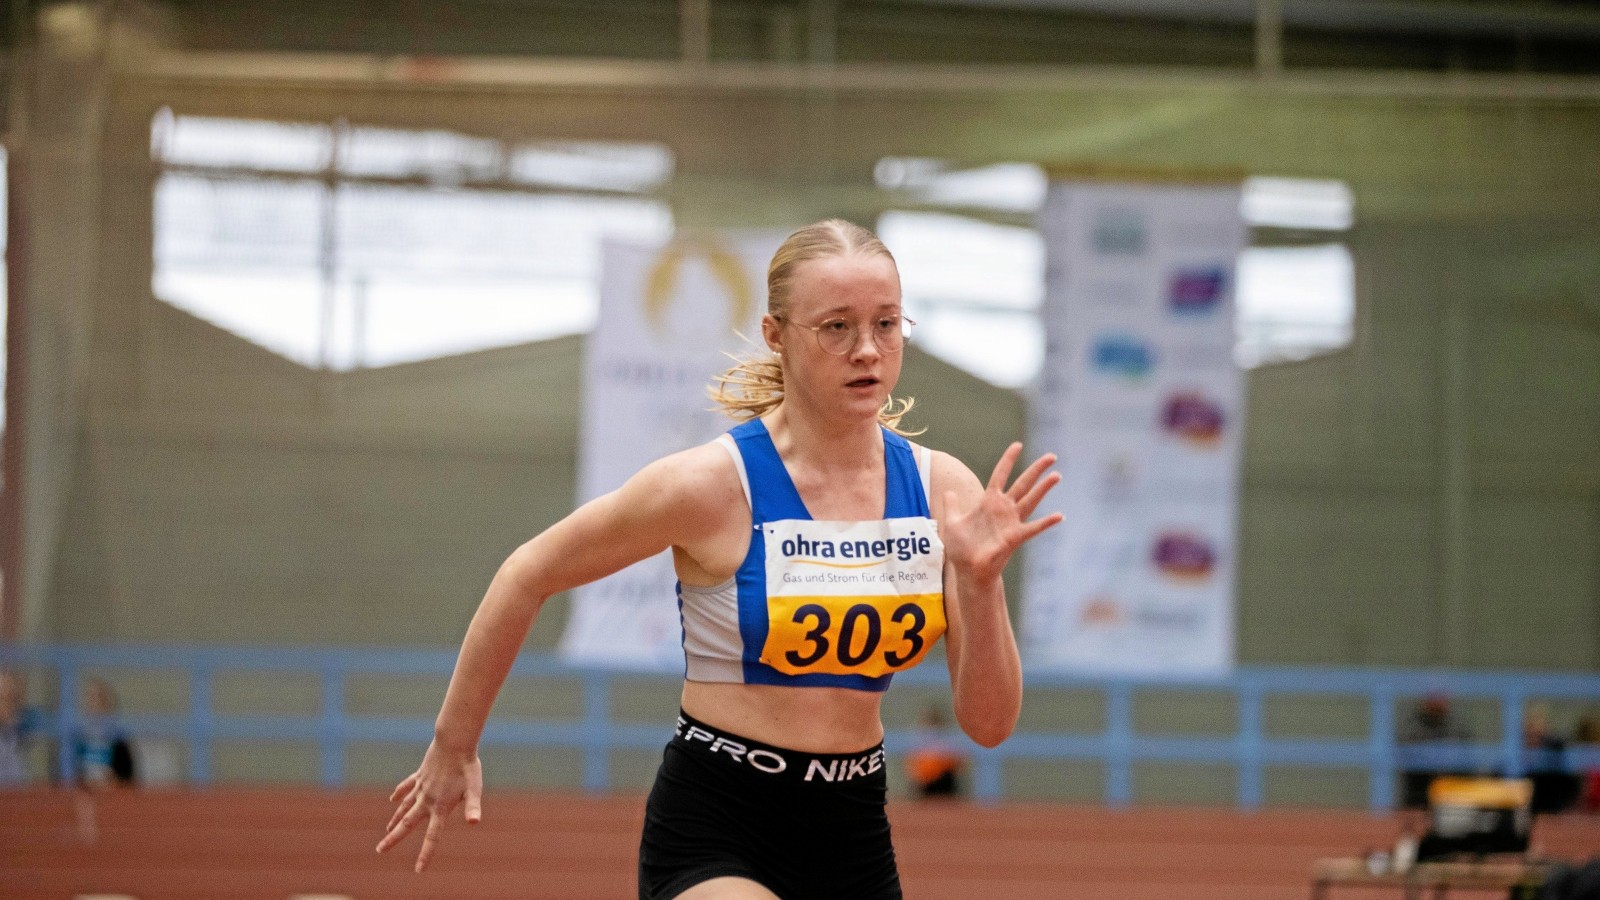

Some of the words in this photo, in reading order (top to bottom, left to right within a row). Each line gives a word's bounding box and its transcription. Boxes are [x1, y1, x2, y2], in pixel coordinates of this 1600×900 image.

[782, 534, 835, 557] ohra
[840, 531, 930, 561] energie
[783, 572, 802, 583] Gas
[805, 572, 825, 583] und
[828, 572, 859, 583] Strom
[862, 572, 876, 583] für
[880, 572, 895, 583] die
[898, 571, 929, 584] Region.
[785, 603, 926, 668] 303
[685, 726, 787, 774] PRO
[804, 749, 882, 782] NIKE
